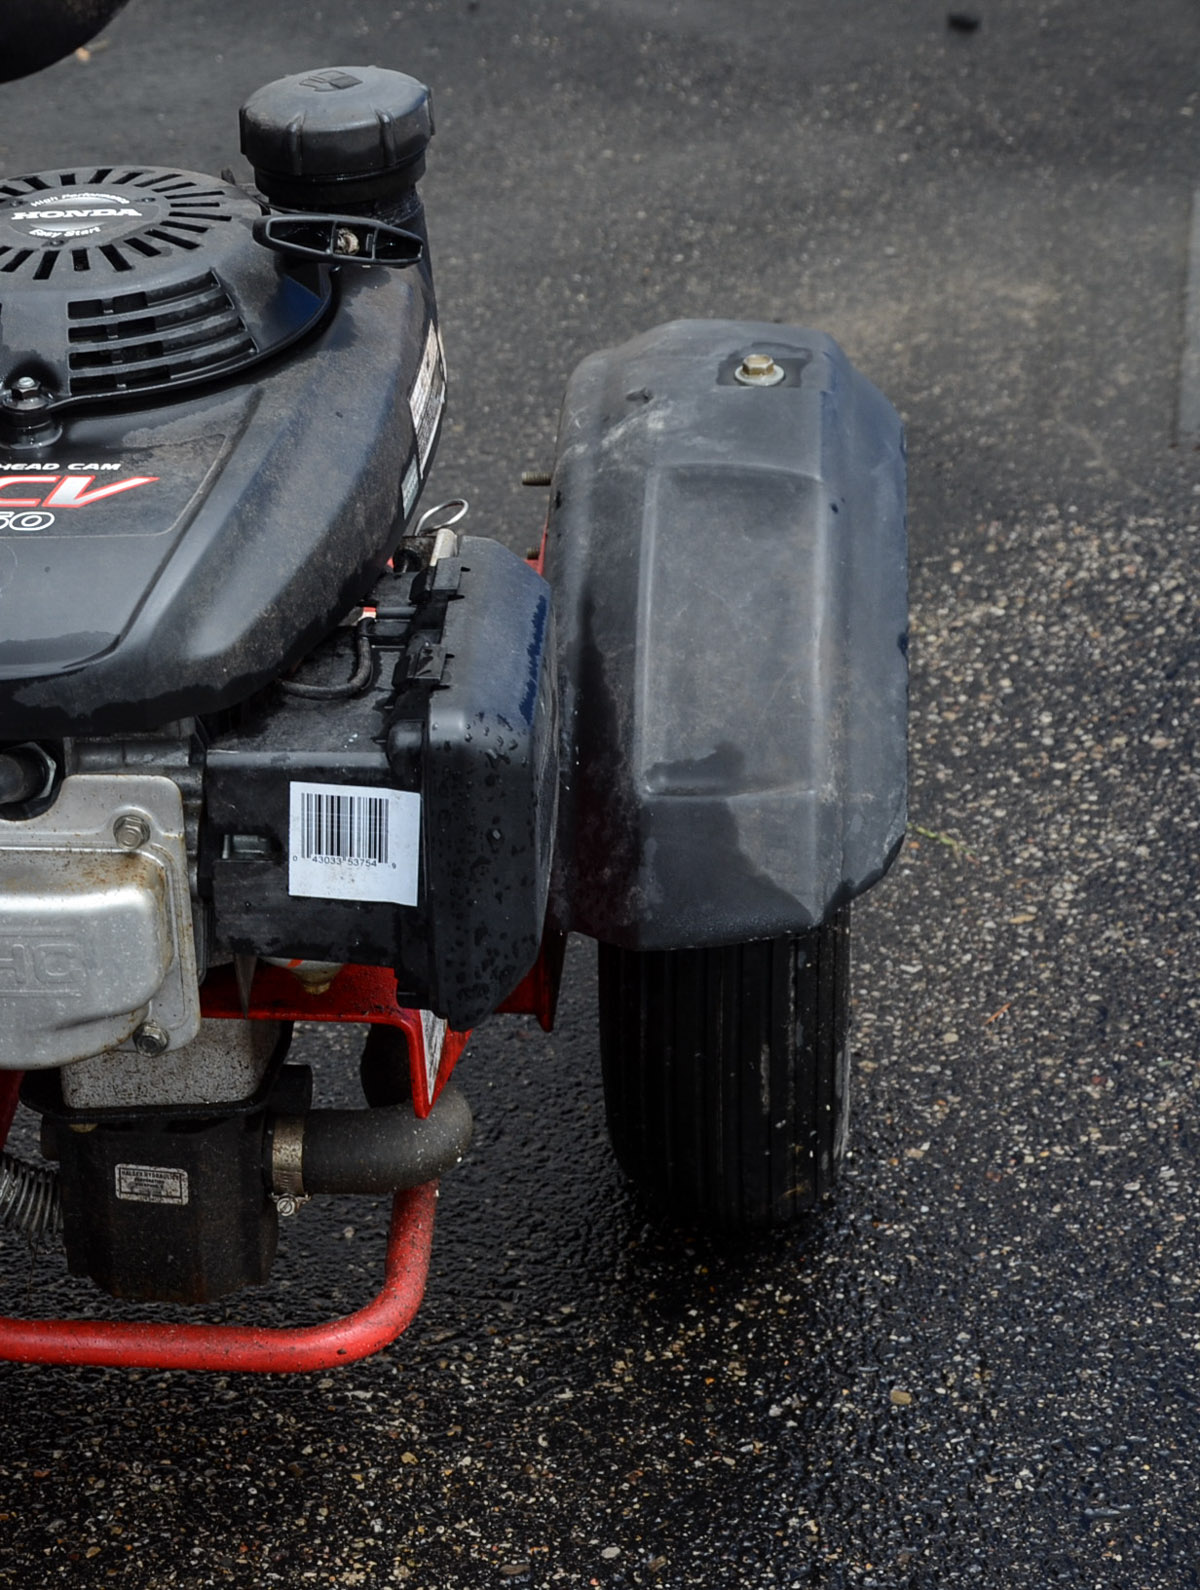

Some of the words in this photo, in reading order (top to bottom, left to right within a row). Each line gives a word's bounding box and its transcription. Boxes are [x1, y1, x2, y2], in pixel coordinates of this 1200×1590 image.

[11, 208, 143, 220] HONDA
[28, 229, 62, 238] Easy
[64, 226, 101, 237] Start
[67, 462, 122, 471] CAM
[312, 855, 342, 865] 43033
